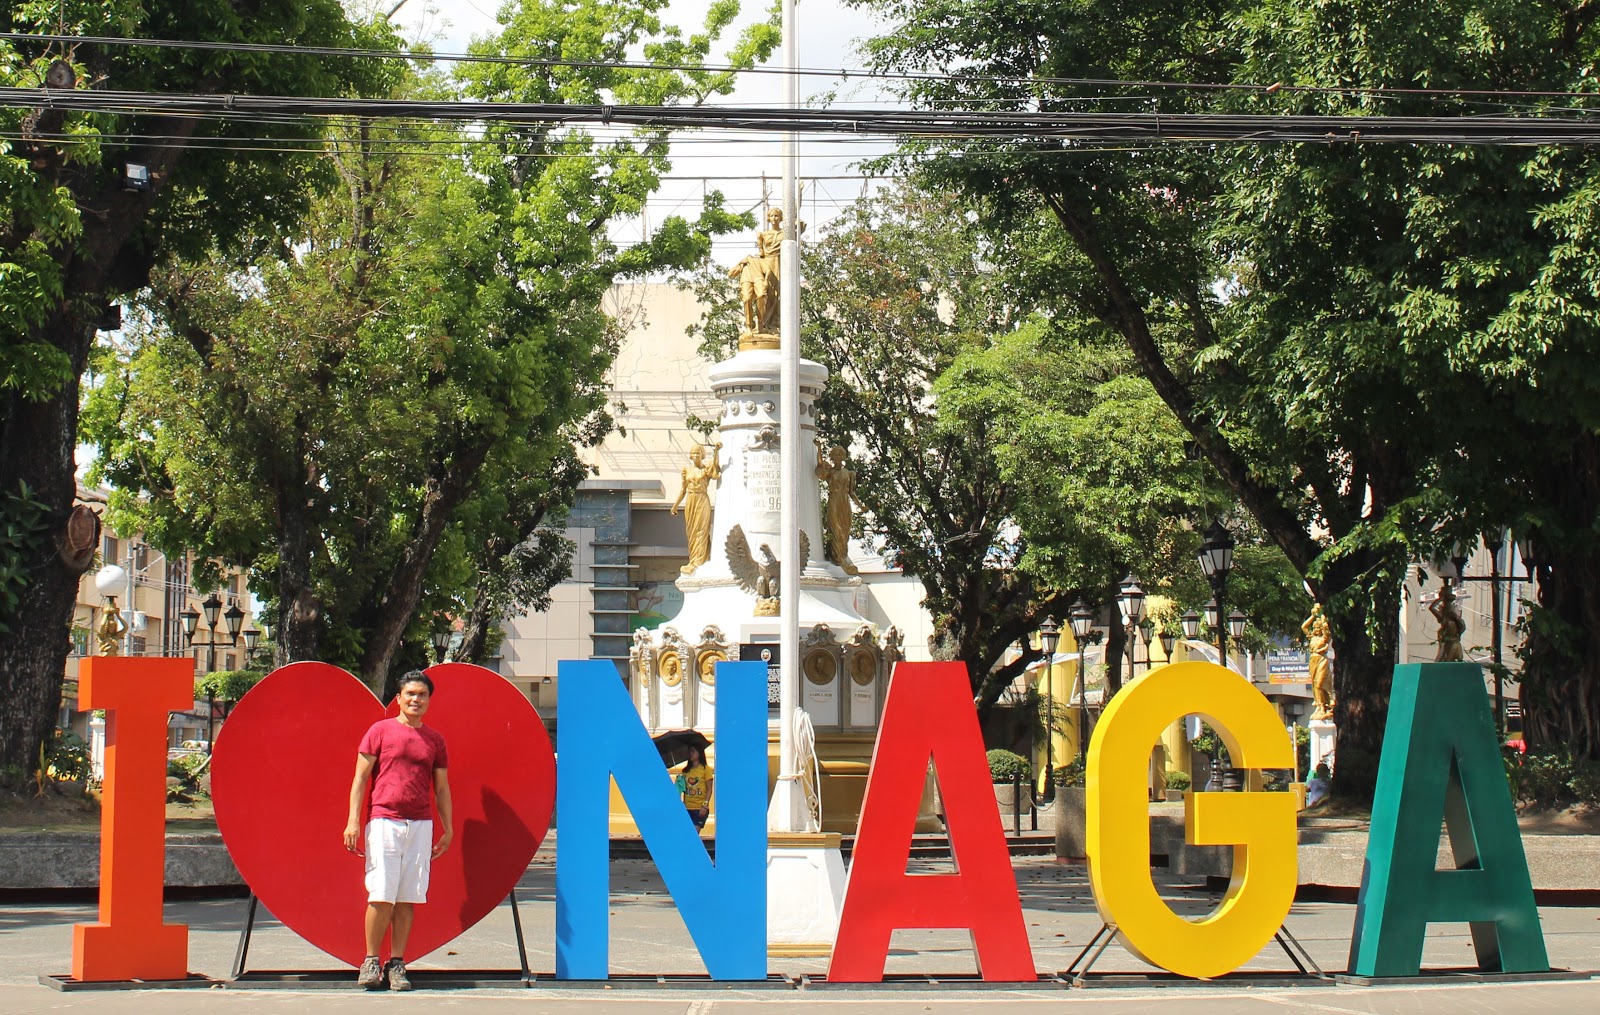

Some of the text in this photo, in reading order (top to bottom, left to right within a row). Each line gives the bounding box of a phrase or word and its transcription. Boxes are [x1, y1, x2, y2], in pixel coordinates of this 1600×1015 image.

[753, 496, 781, 510] DEL 96
[73, 657, 1550, 983] I NAGA
